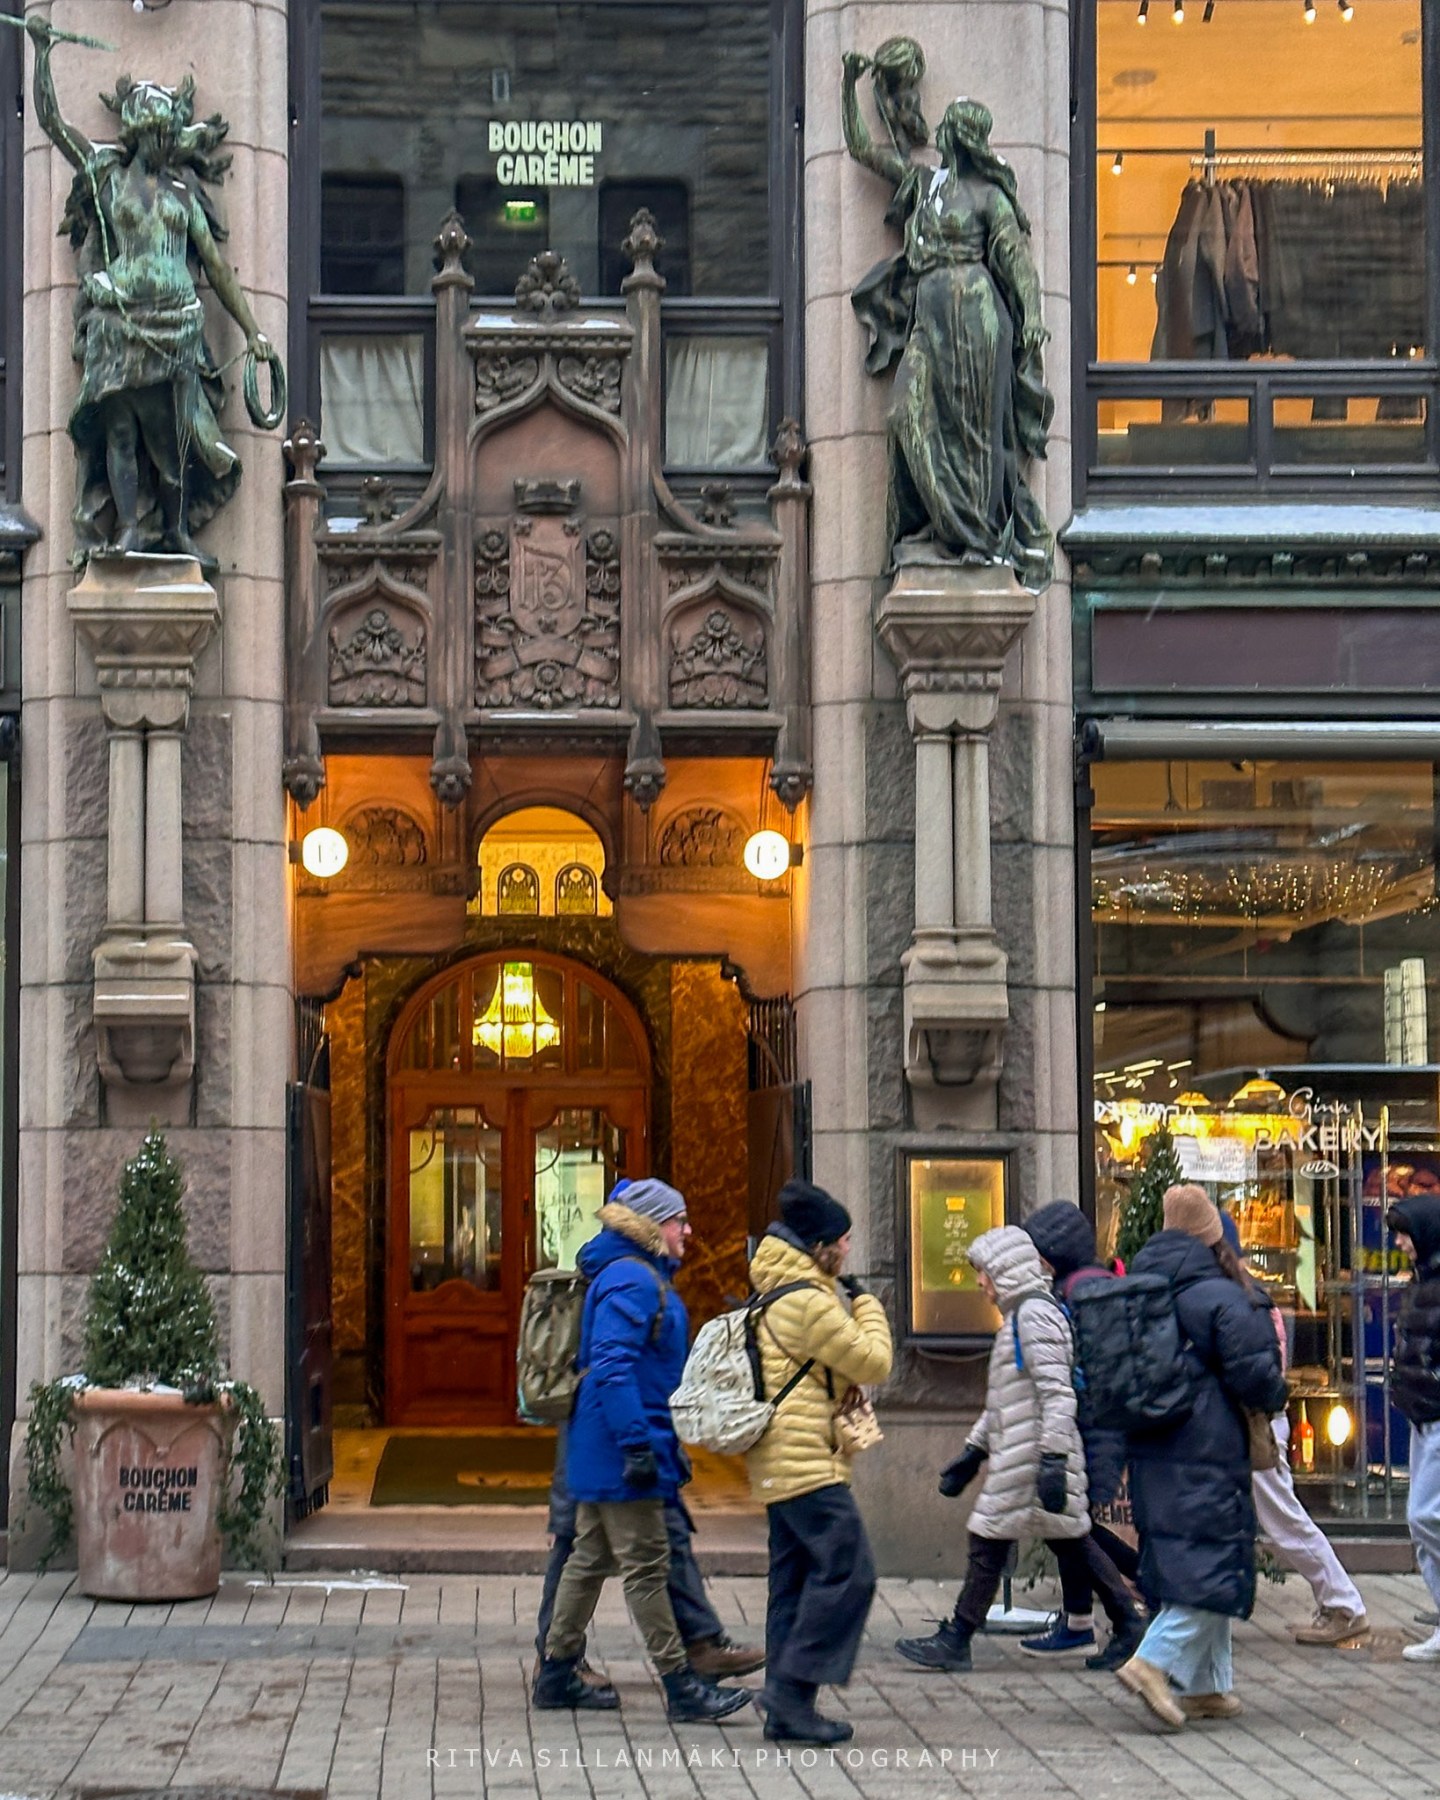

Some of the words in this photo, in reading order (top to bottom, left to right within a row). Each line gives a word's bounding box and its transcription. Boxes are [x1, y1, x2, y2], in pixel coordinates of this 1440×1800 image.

[488, 121, 602, 152] BOUCHON
[496, 149, 594, 186] CARÊME
[1288, 1086, 1351, 1125] Gina
[1254, 1124, 1381, 1151] BAKERY
[119, 1466, 197, 1488] BOUCHON
[123, 1488, 192, 1512] CARÊME
